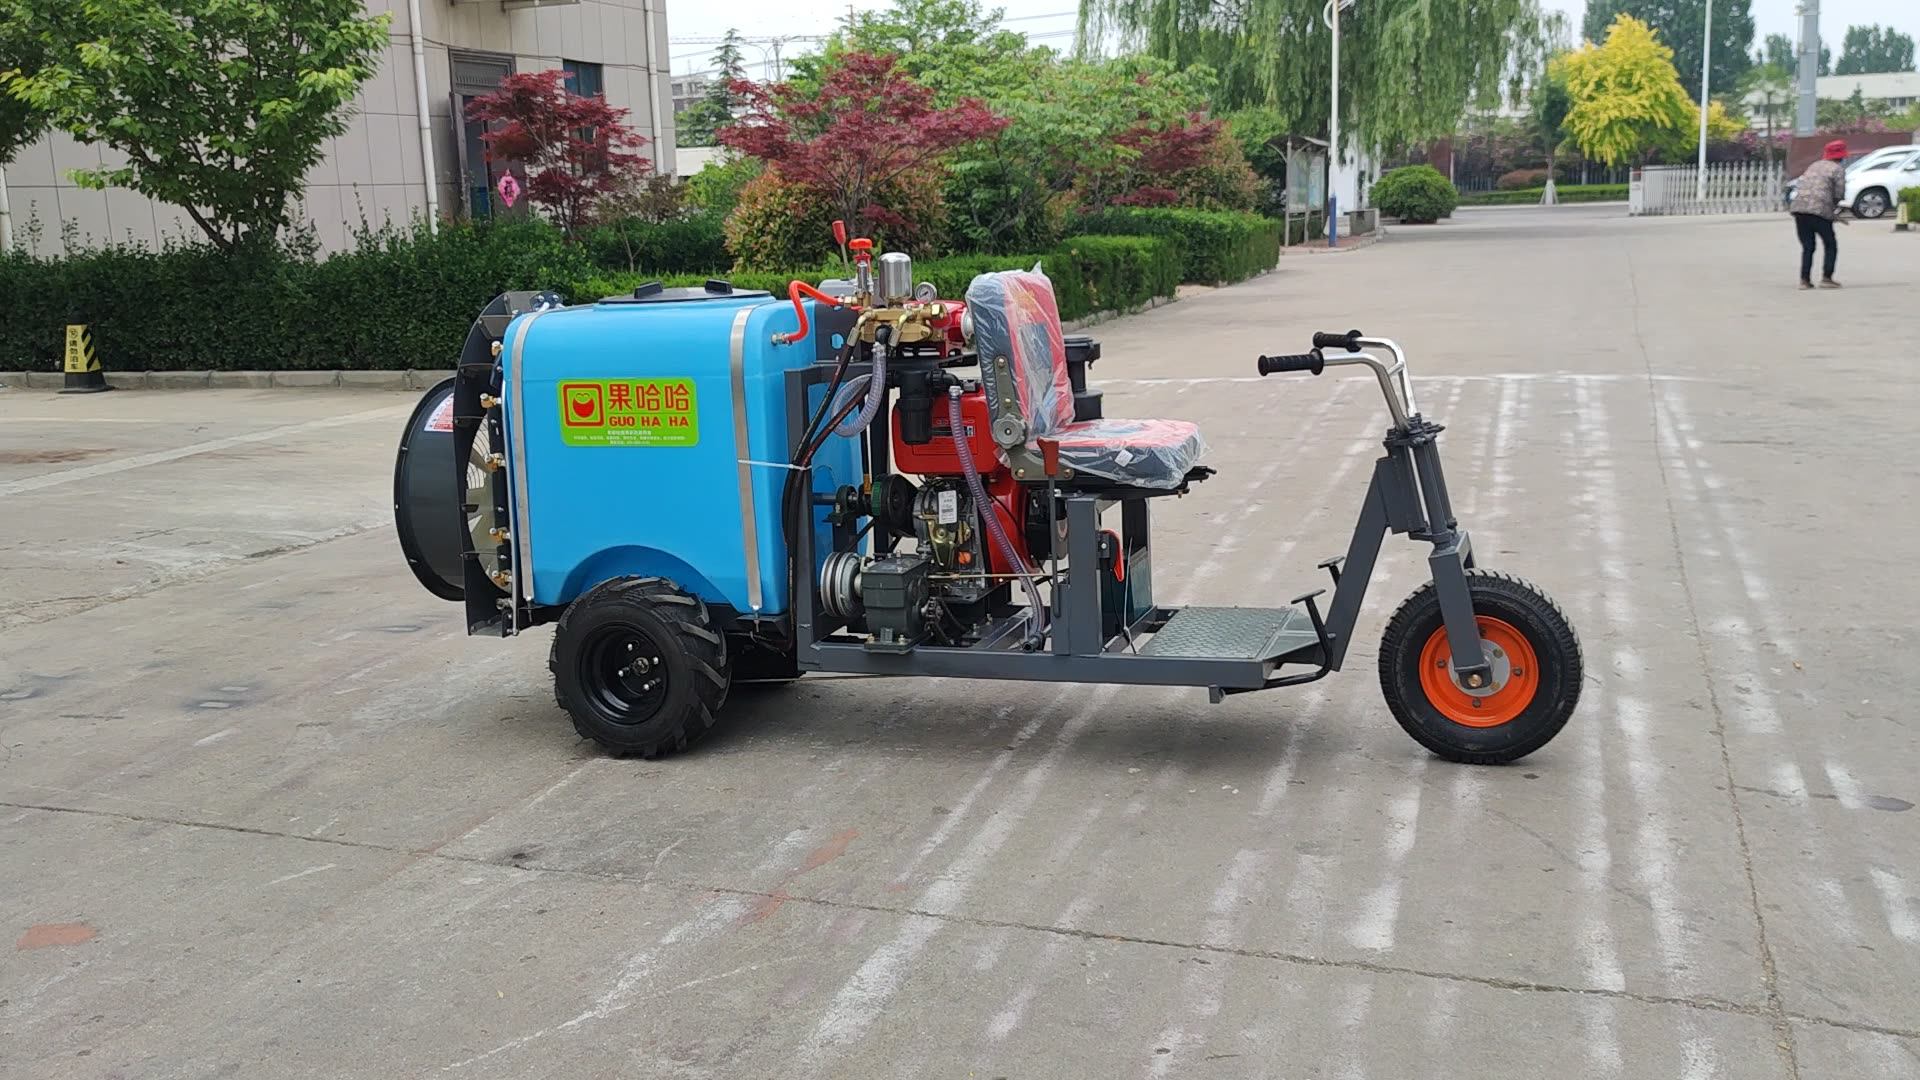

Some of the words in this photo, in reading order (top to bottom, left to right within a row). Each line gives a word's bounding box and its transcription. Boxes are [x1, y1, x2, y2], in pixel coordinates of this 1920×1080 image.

[608, 383, 690, 411] 果哈哈
[608, 416, 636, 427] GUO
[641, 416, 661, 427] HA
[669, 416, 689, 427] HA
